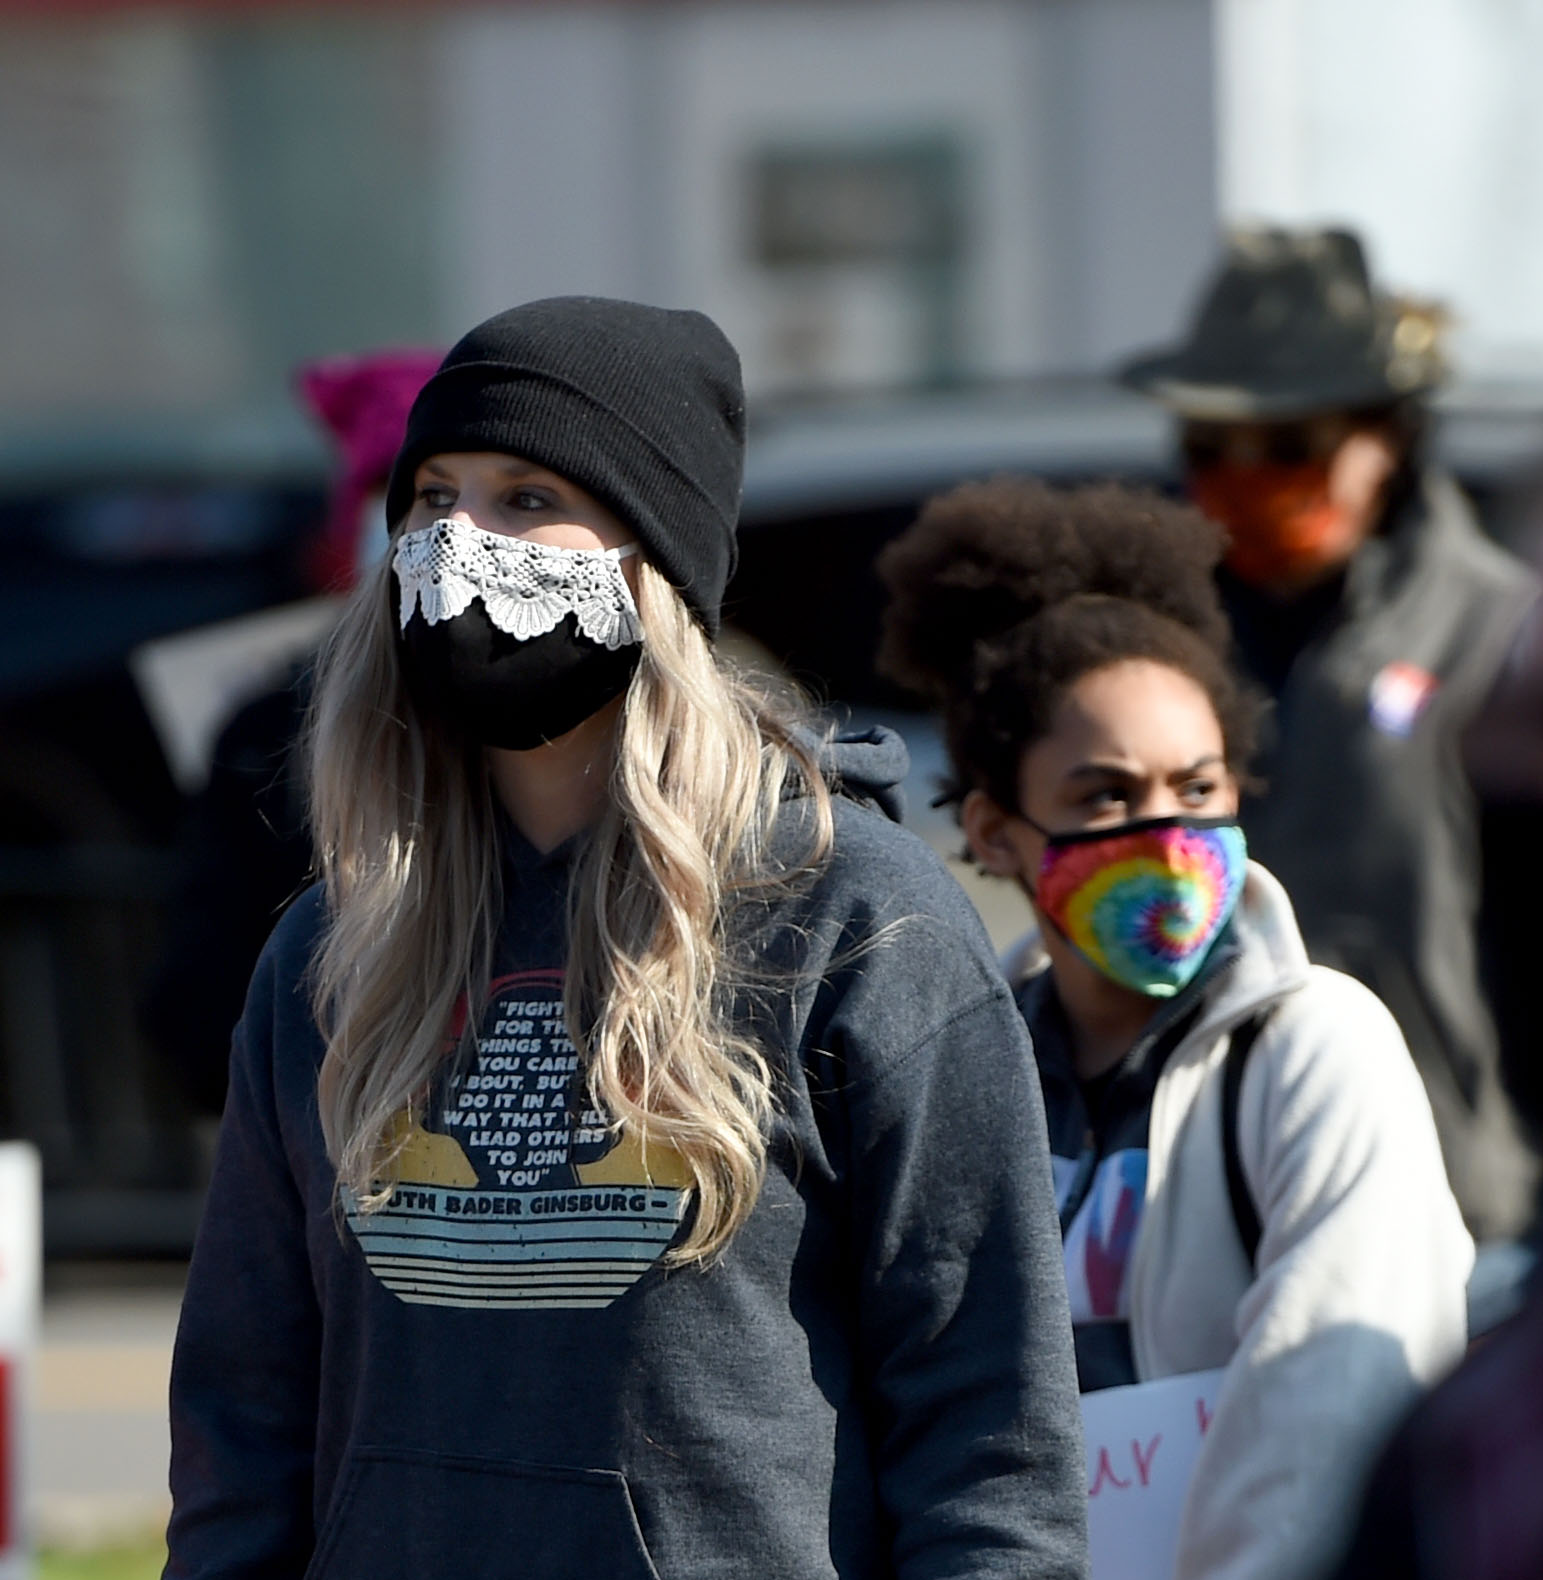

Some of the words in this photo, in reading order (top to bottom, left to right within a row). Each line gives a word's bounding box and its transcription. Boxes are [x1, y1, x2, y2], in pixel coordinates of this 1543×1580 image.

[494, 1020, 533, 1035] FOR
[542, 1020, 569, 1035] TH
[478, 1038, 542, 1054] HINGS
[478, 1057, 520, 1072] YOU
[526, 1057, 579, 1072] CARE
[458, 1093, 489, 1108] DO
[494, 1093, 517, 1108] IT
[522, 1093, 545, 1109] IN
[551, 1093, 565, 1108] A
[443, 1110, 492, 1127] WAY
[499, 1111, 557, 1127] THAT
[564, 1110, 608, 1126] ILL
[469, 1130, 521, 1146] LEAD
[487, 1150, 517, 1166] TO
[523, 1149, 567, 1166] JOIN
[384, 1190, 436, 1214] UTH
[446, 1195, 522, 1216] BADER
[530, 1193, 646, 1214] GINSBURG
